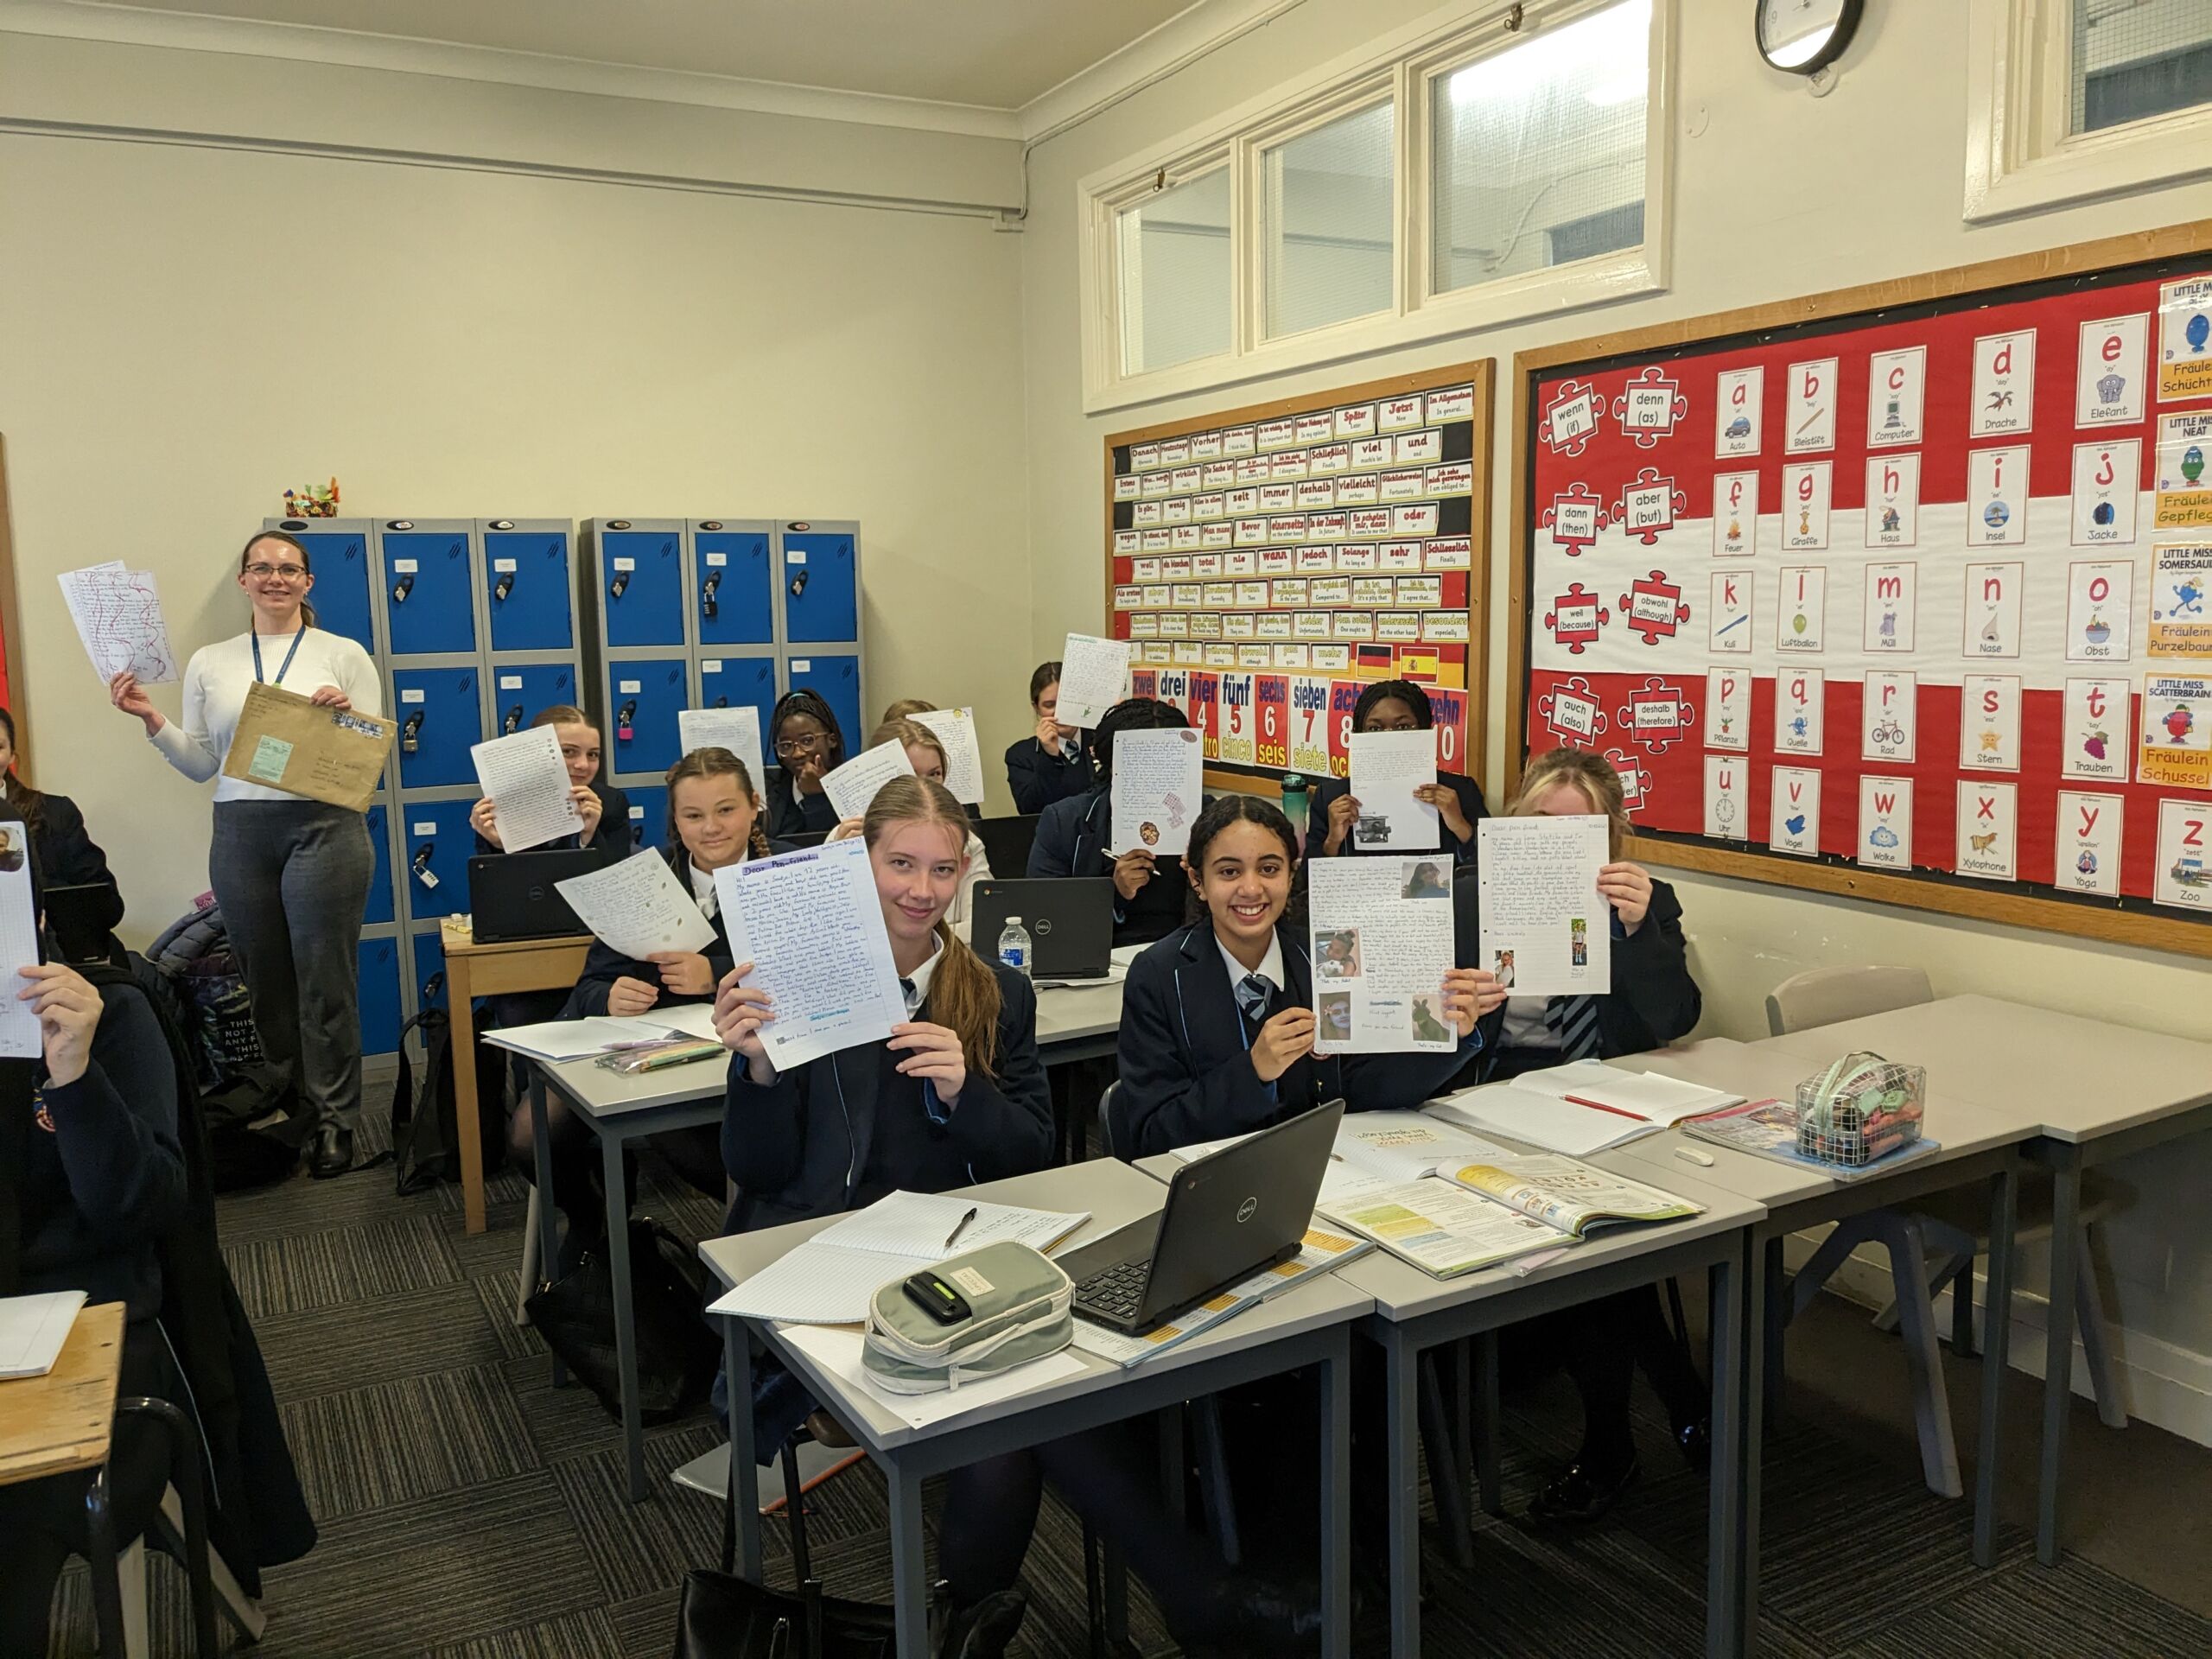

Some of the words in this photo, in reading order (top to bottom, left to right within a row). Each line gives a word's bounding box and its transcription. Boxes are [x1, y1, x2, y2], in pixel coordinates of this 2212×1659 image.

[2174, 284, 2201, 296] LITTLE
[2101, 335, 2122, 361] e
[1993, 343, 2012, 375] d
[2174, 362, 2212, 376] Fräule
[1803, 372, 1819, 398] b
[1889, 367, 1904, 390] c
[2163, 377, 2212, 392] Schücht
[1637, 393, 1663, 405] denn
[1732, 384, 1746, 405] a
[1389, 403, 1414, 415] Jetzt
[1558, 403, 1584, 421] wenn
[2091, 406, 2128, 419] Elefant
[1344, 410, 1367, 424] Später
[1638, 412, 1658, 427] (as)
[1985, 418, 2017, 429] Drache
[2170, 417, 2196, 429] LITTLE
[1567, 420, 1580, 436] (if)
[2183, 426, 2207, 437] NEAT
[1192, 436, 1220, 447] Vorher
[1408, 435, 1427, 448] und
[1795, 435, 1825, 448] Bleistift
[1875, 429, 1915, 442] Computer
[1132, 447, 1158, 457] Danach
[1362, 442, 1382, 453] viel
[1175, 469, 1198, 479] wirklich
[1994, 457, 2003, 488] i
[2095, 452, 2114, 486] j
[1338, 478, 1376, 490] vielleicht
[1884, 465, 1899, 494] h
[1263, 488, 1290, 498] immer
[1300, 482, 1331, 494] deshalb
[1729, 480, 1742, 507] f
[1799, 474, 1813, 501] g
[1233, 492, 1249, 502] seit
[1636, 493, 1660, 505] aber
[1168, 501, 1185, 511] wenig
[1565, 507, 1587, 518] dann
[1404, 509, 1427, 520] oder
[1637, 511, 1662, 526] (but)
[1242, 522, 1260, 531] Bevor
[1562, 522, 1588, 536] (then)
[1791, 537, 1818, 546] Giraffe
[1881, 534, 1900, 543] Haus
[1986, 531, 2005, 540] Insel
[2088, 530, 2118, 540] Jacke
[1263, 551, 1287, 561] wann
[1301, 549, 1328, 563] jedoch
[1390, 546, 1409, 556] sehr
[2164, 549, 2190, 558] LITTLE
[1198, 556, 1215, 566] total
[1725, 579, 1738, 604] k
[1878, 576, 1901, 599] m
[1984, 578, 2001, 601] n
[2088, 577, 2109, 602] o
[1641, 597, 1669, 608] obwohl
[1634, 607, 1672, 623] (although)
[1560, 620, 1594, 630] (because)
[2161, 625, 2211, 637] Fräulein
[1781, 639, 1818, 648] Luftballon
[1881, 639, 1897, 647] Müll
[1980, 644, 2002, 653] Nase
[2085, 646, 2110, 656] Obst
[1133, 671, 1155, 695] zwei
[1160, 671, 1185, 696] drei
[1190, 671, 1217, 702] vier
[1223, 674, 1250, 706] fünf
[1259, 677, 1285, 703] sechs
[1721, 677, 1735, 703] p
[2157, 680, 2182, 689] LITTLE
[1294, 678, 1325, 710] sieben
[1334, 683, 1363, 710] ach
[1791, 678, 1808, 706] q
[1883, 684, 1897, 707] r
[2149, 688, 2210, 698] SCATTERBRAIN
[1431, 690, 1459, 725] zehn
[1564, 701, 1586, 715] auch
[1983, 690, 1999, 713] s
[2086, 687, 2106, 718] t
[1197, 702, 1207, 728] 4
[1642, 705, 1669, 714] deshalb
[1230, 704, 1242, 734] 5
[1264, 705, 1276, 737] 6
[1302, 709, 1315, 742] 7
[1560, 714, 1586, 732] (also)
[1637, 716, 1675, 728] (therefore)
[1340, 715, 1353, 749] 8
[1714, 734, 1738, 744] Pflanze
[1203, 732, 1218, 758] tro
[1223, 734, 1253, 761] cinco
[1787, 738, 1808, 747] Quelle
[1258, 742, 1286, 766] seis
[1294, 742, 1327, 772] siete
[1880, 746, 1895, 754] Rad
[1977, 753, 2002, 764] Stern
[2146, 749, 2209, 766] Fräulein
[2075, 761, 2113, 773] Trauben
[1719, 770, 1732, 790] u
[2142, 767, 2209, 785] Schussel
[1789, 781, 1802, 803] v
[1874, 791, 1895, 815] w
[1977, 797, 1995, 820] x
[2078, 806, 2100, 838] y
[2183, 820, 2203, 847] z
[1784, 838, 1803, 849] Vogel
[1873, 852, 1895, 862] Wolke
[743, 866, 766, 875] Dear
[1963, 858, 2006, 873] Xylophone
[2075, 876, 2097, 889] Yoga
[2180, 890, 2200, 902] Zoo
[230, 1019, 254, 1027] THIS
[225, 1038, 246, 1046] ANY
[235, 1044, 259, 1053] THIS
